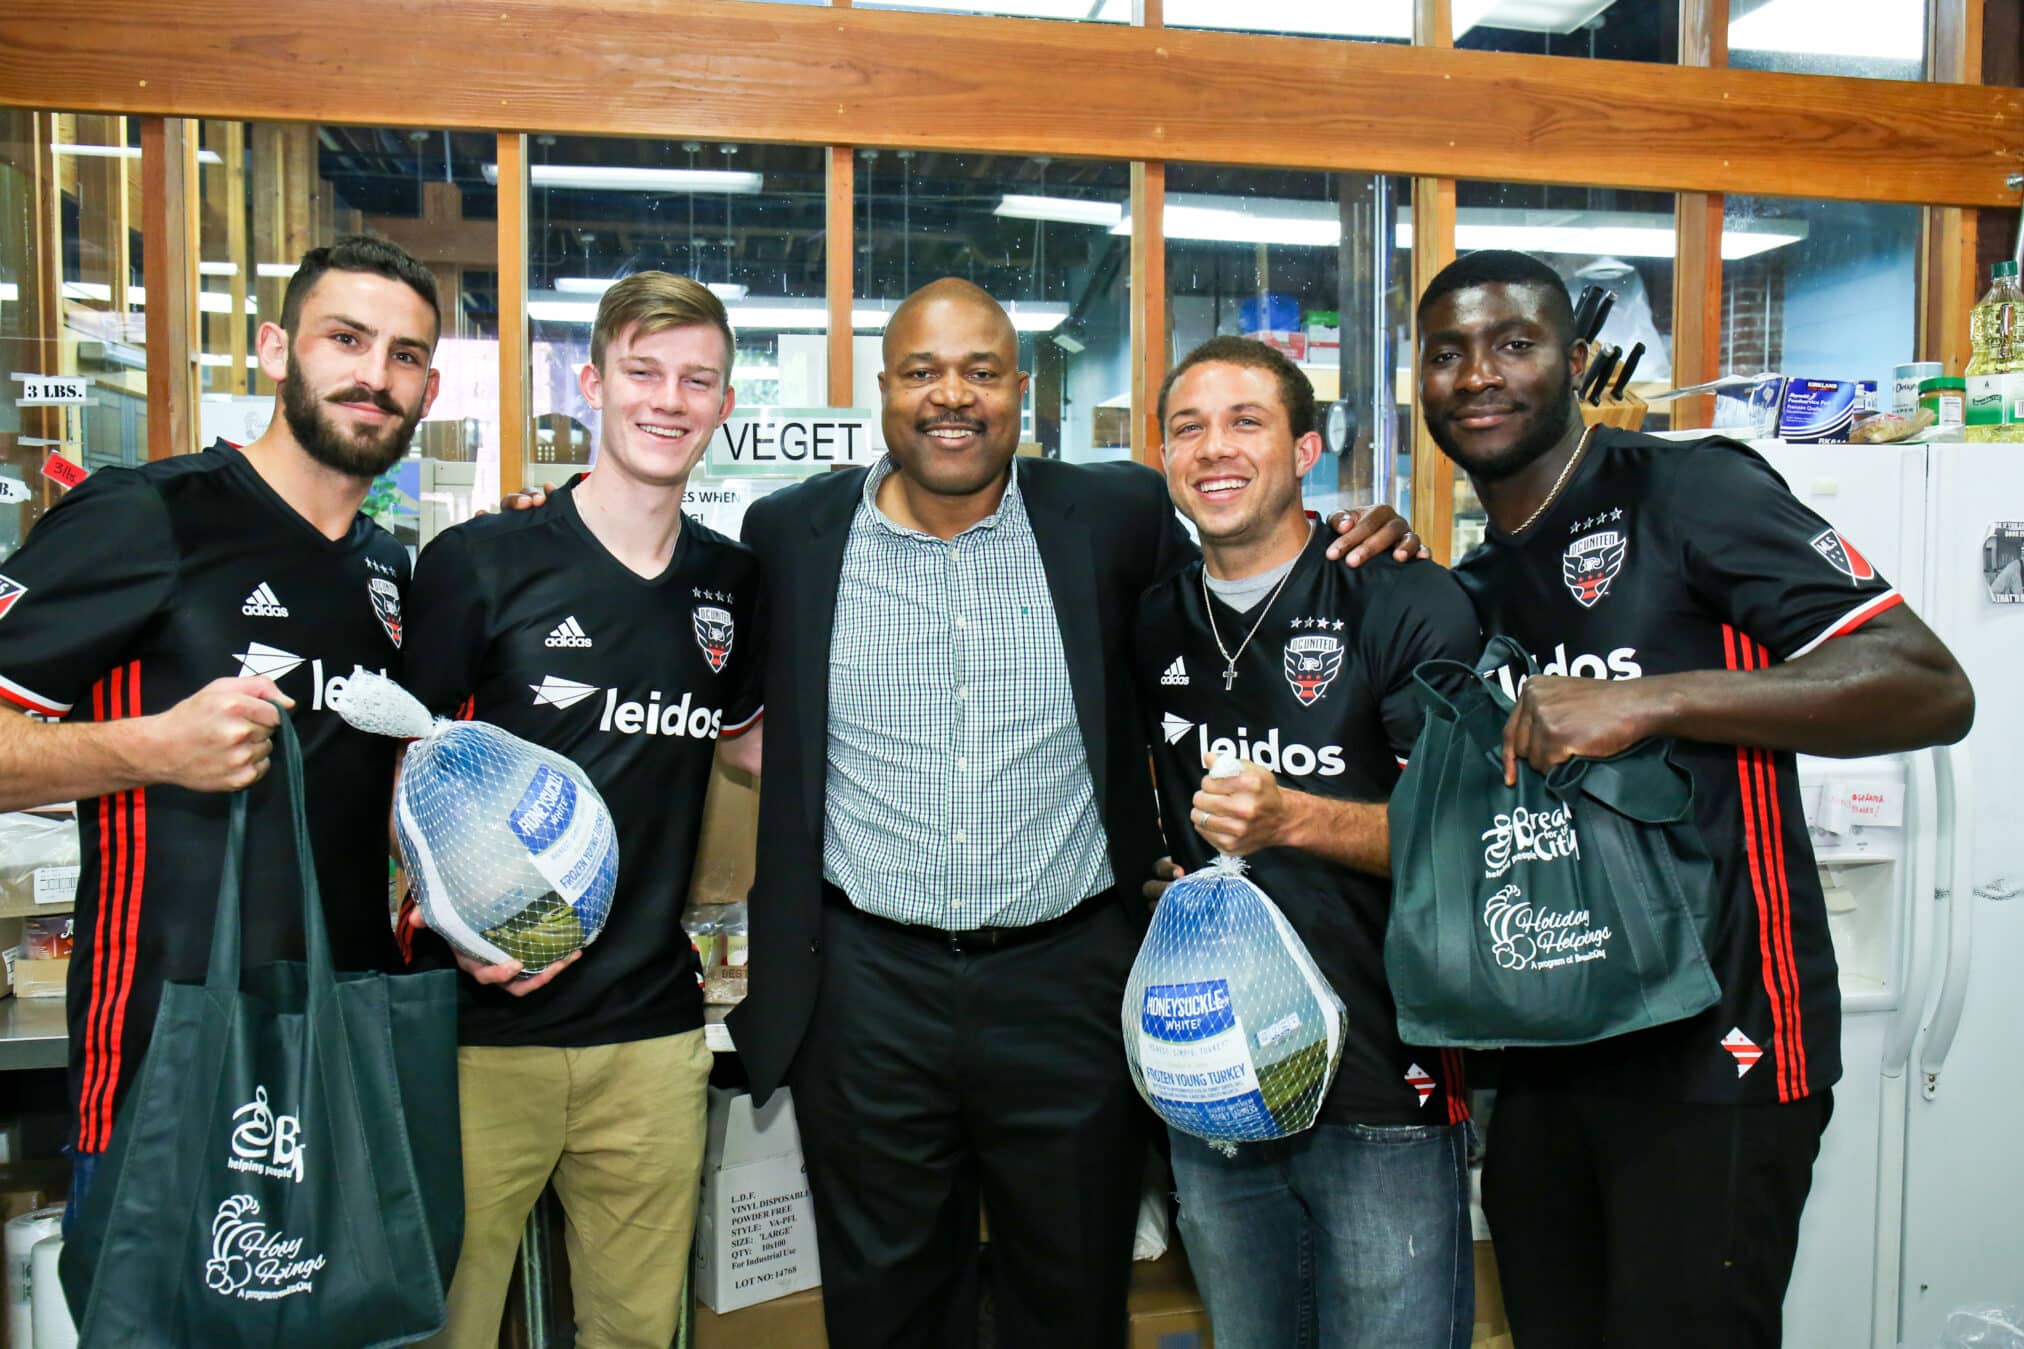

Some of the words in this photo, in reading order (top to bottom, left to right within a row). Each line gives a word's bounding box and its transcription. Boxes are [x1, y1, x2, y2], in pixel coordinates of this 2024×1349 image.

[28, 385, 38, 398] 3
[44, 385, 83, 398] LBS.
[723, 422, 862, 461] VEGET
[698, 491, 741, 503] WHEN
[242, 604, 289, 618] adidas
[545, 634, 593, 648] adidas
[1160, 674, 1190, 685] adidas
[600, 688, 723, 740] leidos
[1515, 906, 1590, 933] Holiday
[1536, 926, 1612, 953] Helpings
[1146, 988, 1225, 1017] HONEYSUCKLE
[1165, 1018, 1197, 1031] WHITE
[1146, 1066, 1175, 1086] FROZEN
[1175, 1072, 1208, 1087] YOUNG
[1207, 1062, 1246, 1085] TURKEY
[227, 1157, 264, 1175] helping
[731, 1192, 756, 1203] L.D.F.
[731, 1204, 758, 1214] VINYL
[731, 1211, 769, 1226] POWDER
[771, 1204, 792, 1217] FREE
[731, 1224, 762, 1238] STYLE:
[769, 1215, 798, 1228] VA-PFL
[731, 1237, 753, 1249] SIZE:
[731, 1248, 752, 1260] QTY:
[762, 1239, 786, 1251] 10x100
[731, 1260, 745, 1270] For
[746, 1249, 782, 1266] Industrial
[783, 1247, 797, 1256] Use
[735, 1277, 755, 1289] LOT
[757, 1271, 774, 1283] NO:
[775, 1265, 797, 1279] 14768
